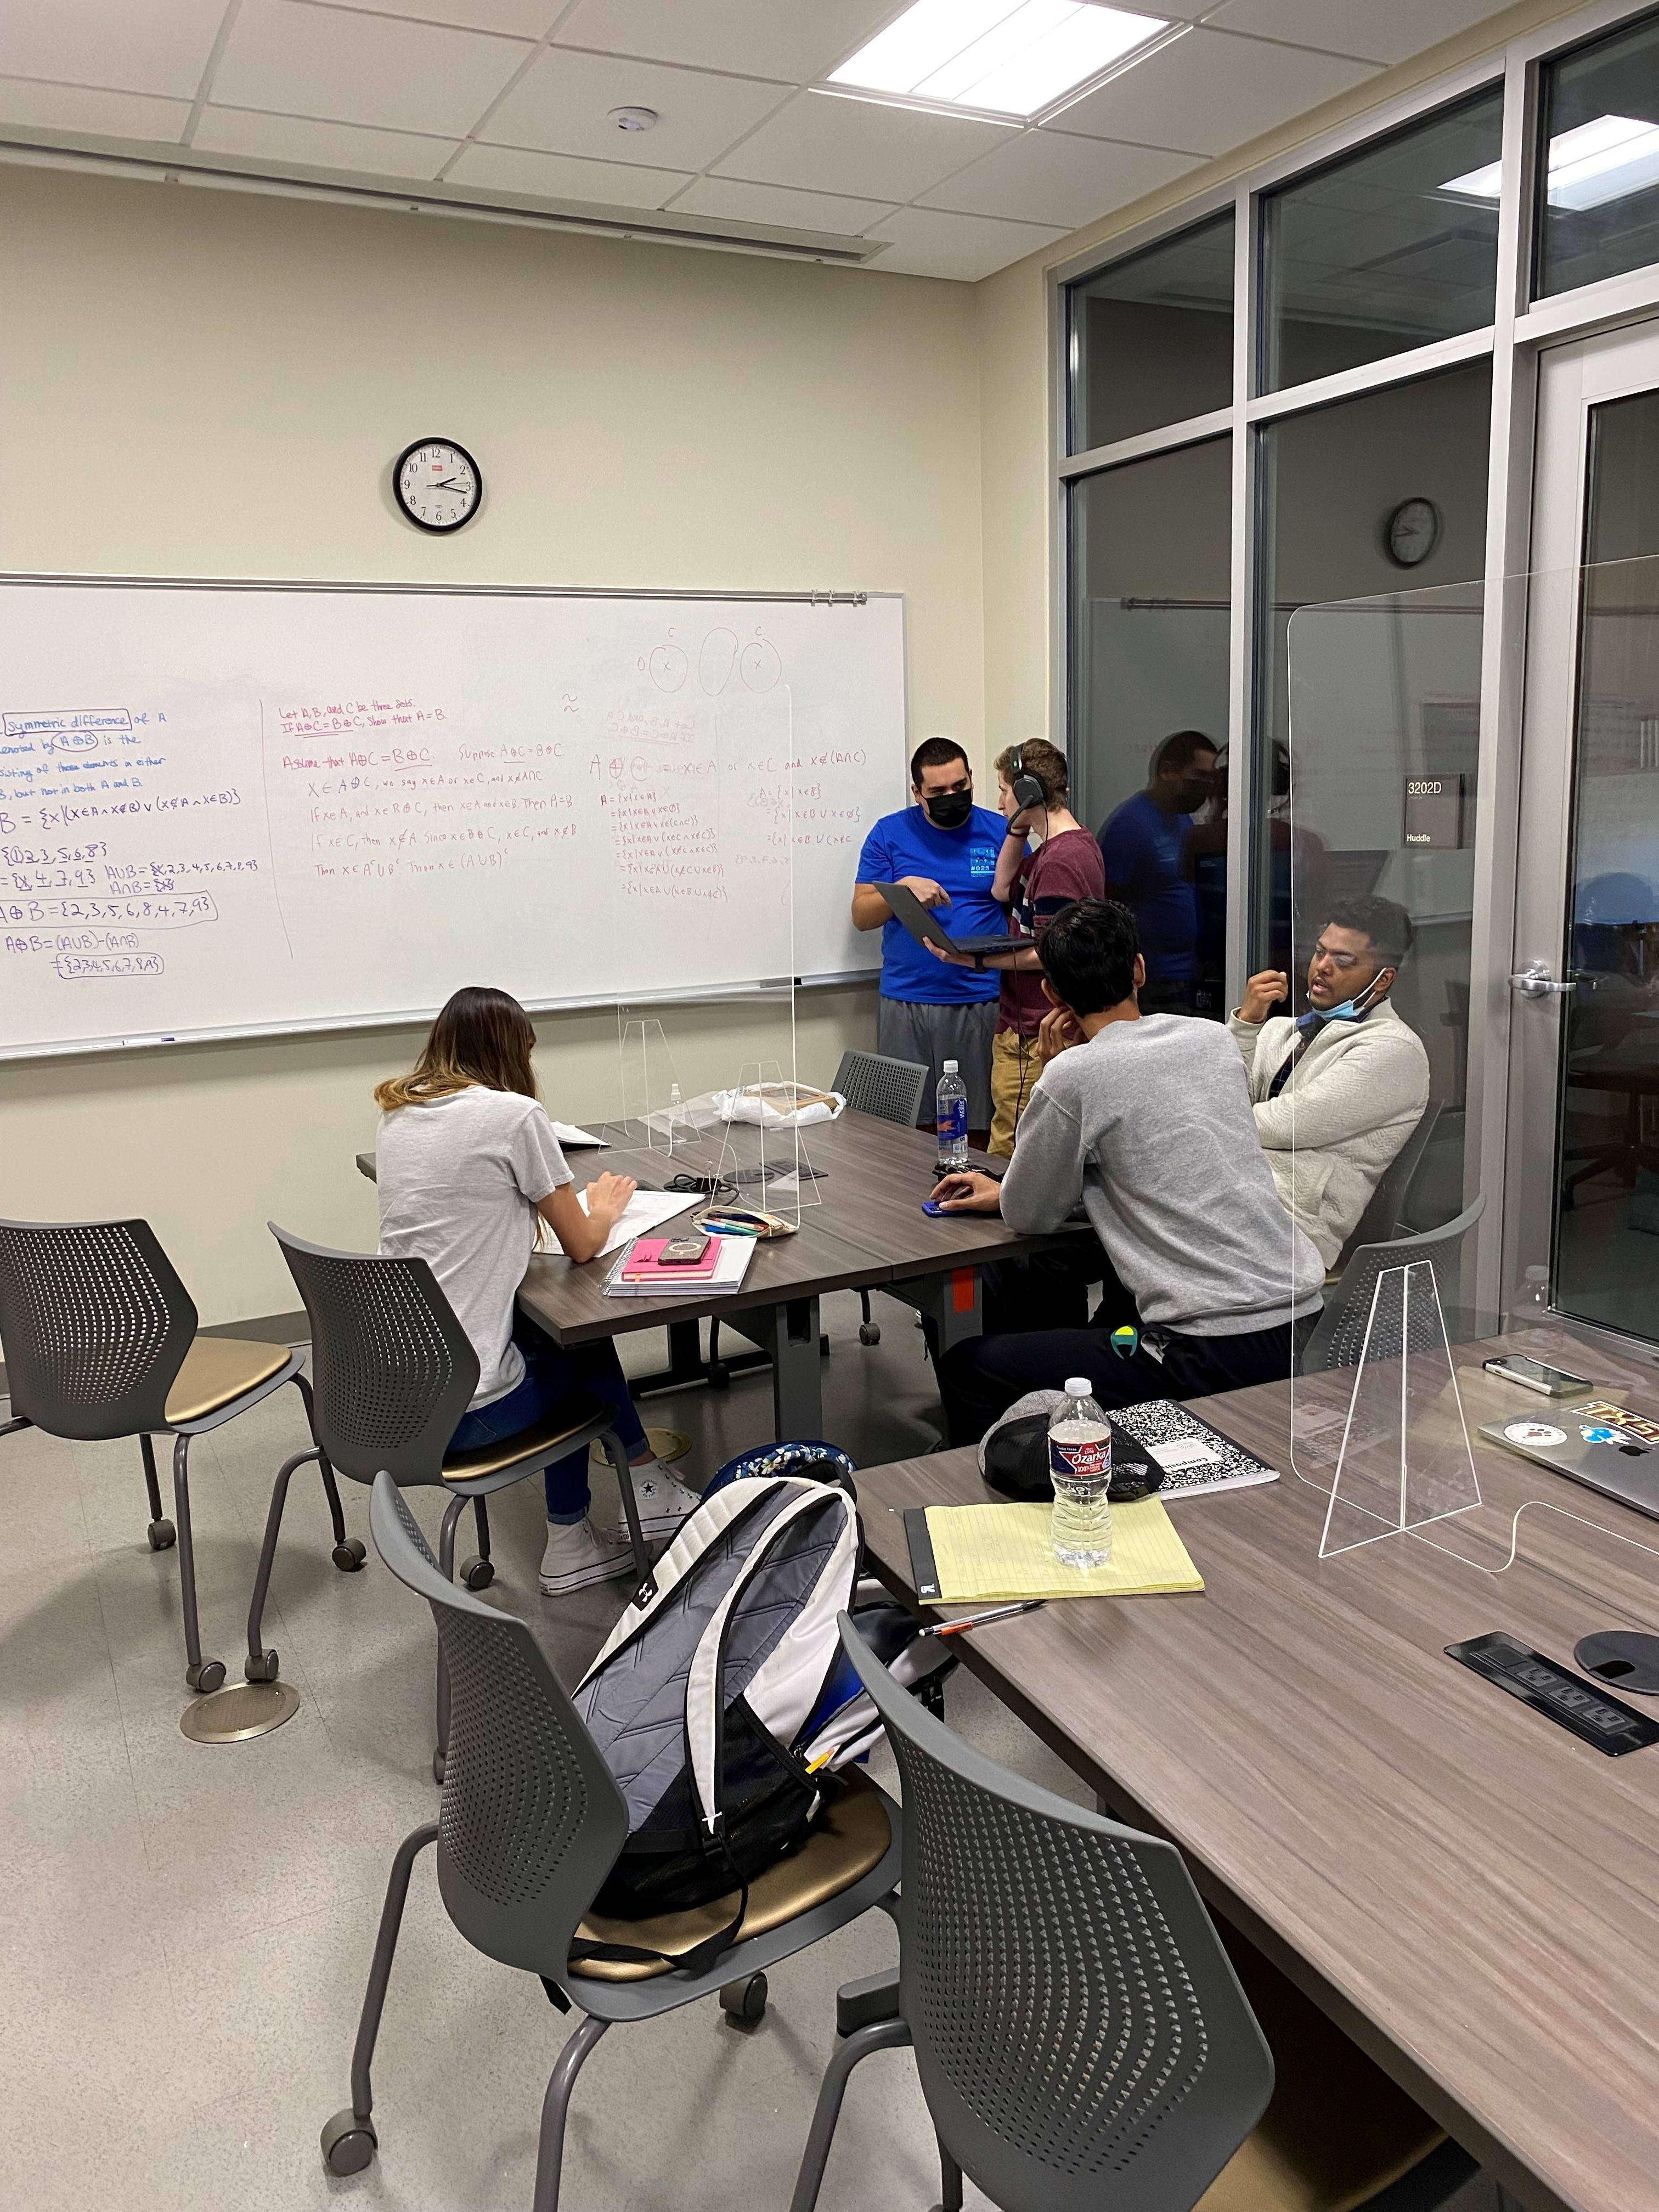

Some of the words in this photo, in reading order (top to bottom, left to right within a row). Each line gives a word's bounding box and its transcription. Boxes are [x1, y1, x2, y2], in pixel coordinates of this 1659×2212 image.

[420, 453, 426, 462] 11
[432, 449, 441, 458] 12
[450, 453, 453, 463] 1
[409, 463, 417, 473] 10
[460, 466, 466, 475] 2
[404, 479, 410, 489] 9
[466, 482, 471, 491] 3
[410, 495, 416, 505] 8
[460, 498, 466, 507] 4
[421, 506, 426, 516] 7
[436, 511, 442, 521] 6
[451, 509, 456, 518] 5
[279, 708, 298, 719] Let
[327, 704, 344, 715] and
[346, 703, 354, 713] C
[358, 701, 369, 712] be
[370, 700, 393, 711] three
[71, 714, 129, 728] difference
[134, 713, 149, 724] of
[158, 713, 166, 723] A
[281, 723, 294, 733] If
[391, 714, 412, 724] that
[42, 739, 54, 754] by
[104, 735, 111, 745] is
[119, 733, 140, 744] the
[459, 743, 495, 761] Suppose
[37, 764, 49, 774] of
[125, 758, 132, 766] in
[137, 757, 166, 766] either
[283, 755, 320, 769] Assume
[323, 755, 344, 768] that
[728, 763, 737, 771] or
[785, 758, 803, 770] and
[14, 789, 35, 798] but
[41, 786, 58, 795] not
[61, 785, 70, 794] in
[74, 783, 95, 793] both
[101, 780, 109, 789] A
[114, 779, 128, 788] and
[402, 779, 416, 790] say
[492, 774, 503, 783] and
[1408, 782, 1442, 794] 3202D
[311, 806, 319, 823] If
[356, 806, 369, 818] and
[433, 802, 454, 812] then
[483, 797, 496, 808] and
[521, 797, 546, 811] Then
[362, 832, 381, 845] then
[537, 828, 548, 837] and
[314, 864, 335, 876] Then
[407, 861, 433, 873] Then
[1071, 1451, 1106, 1464] Ozarka
